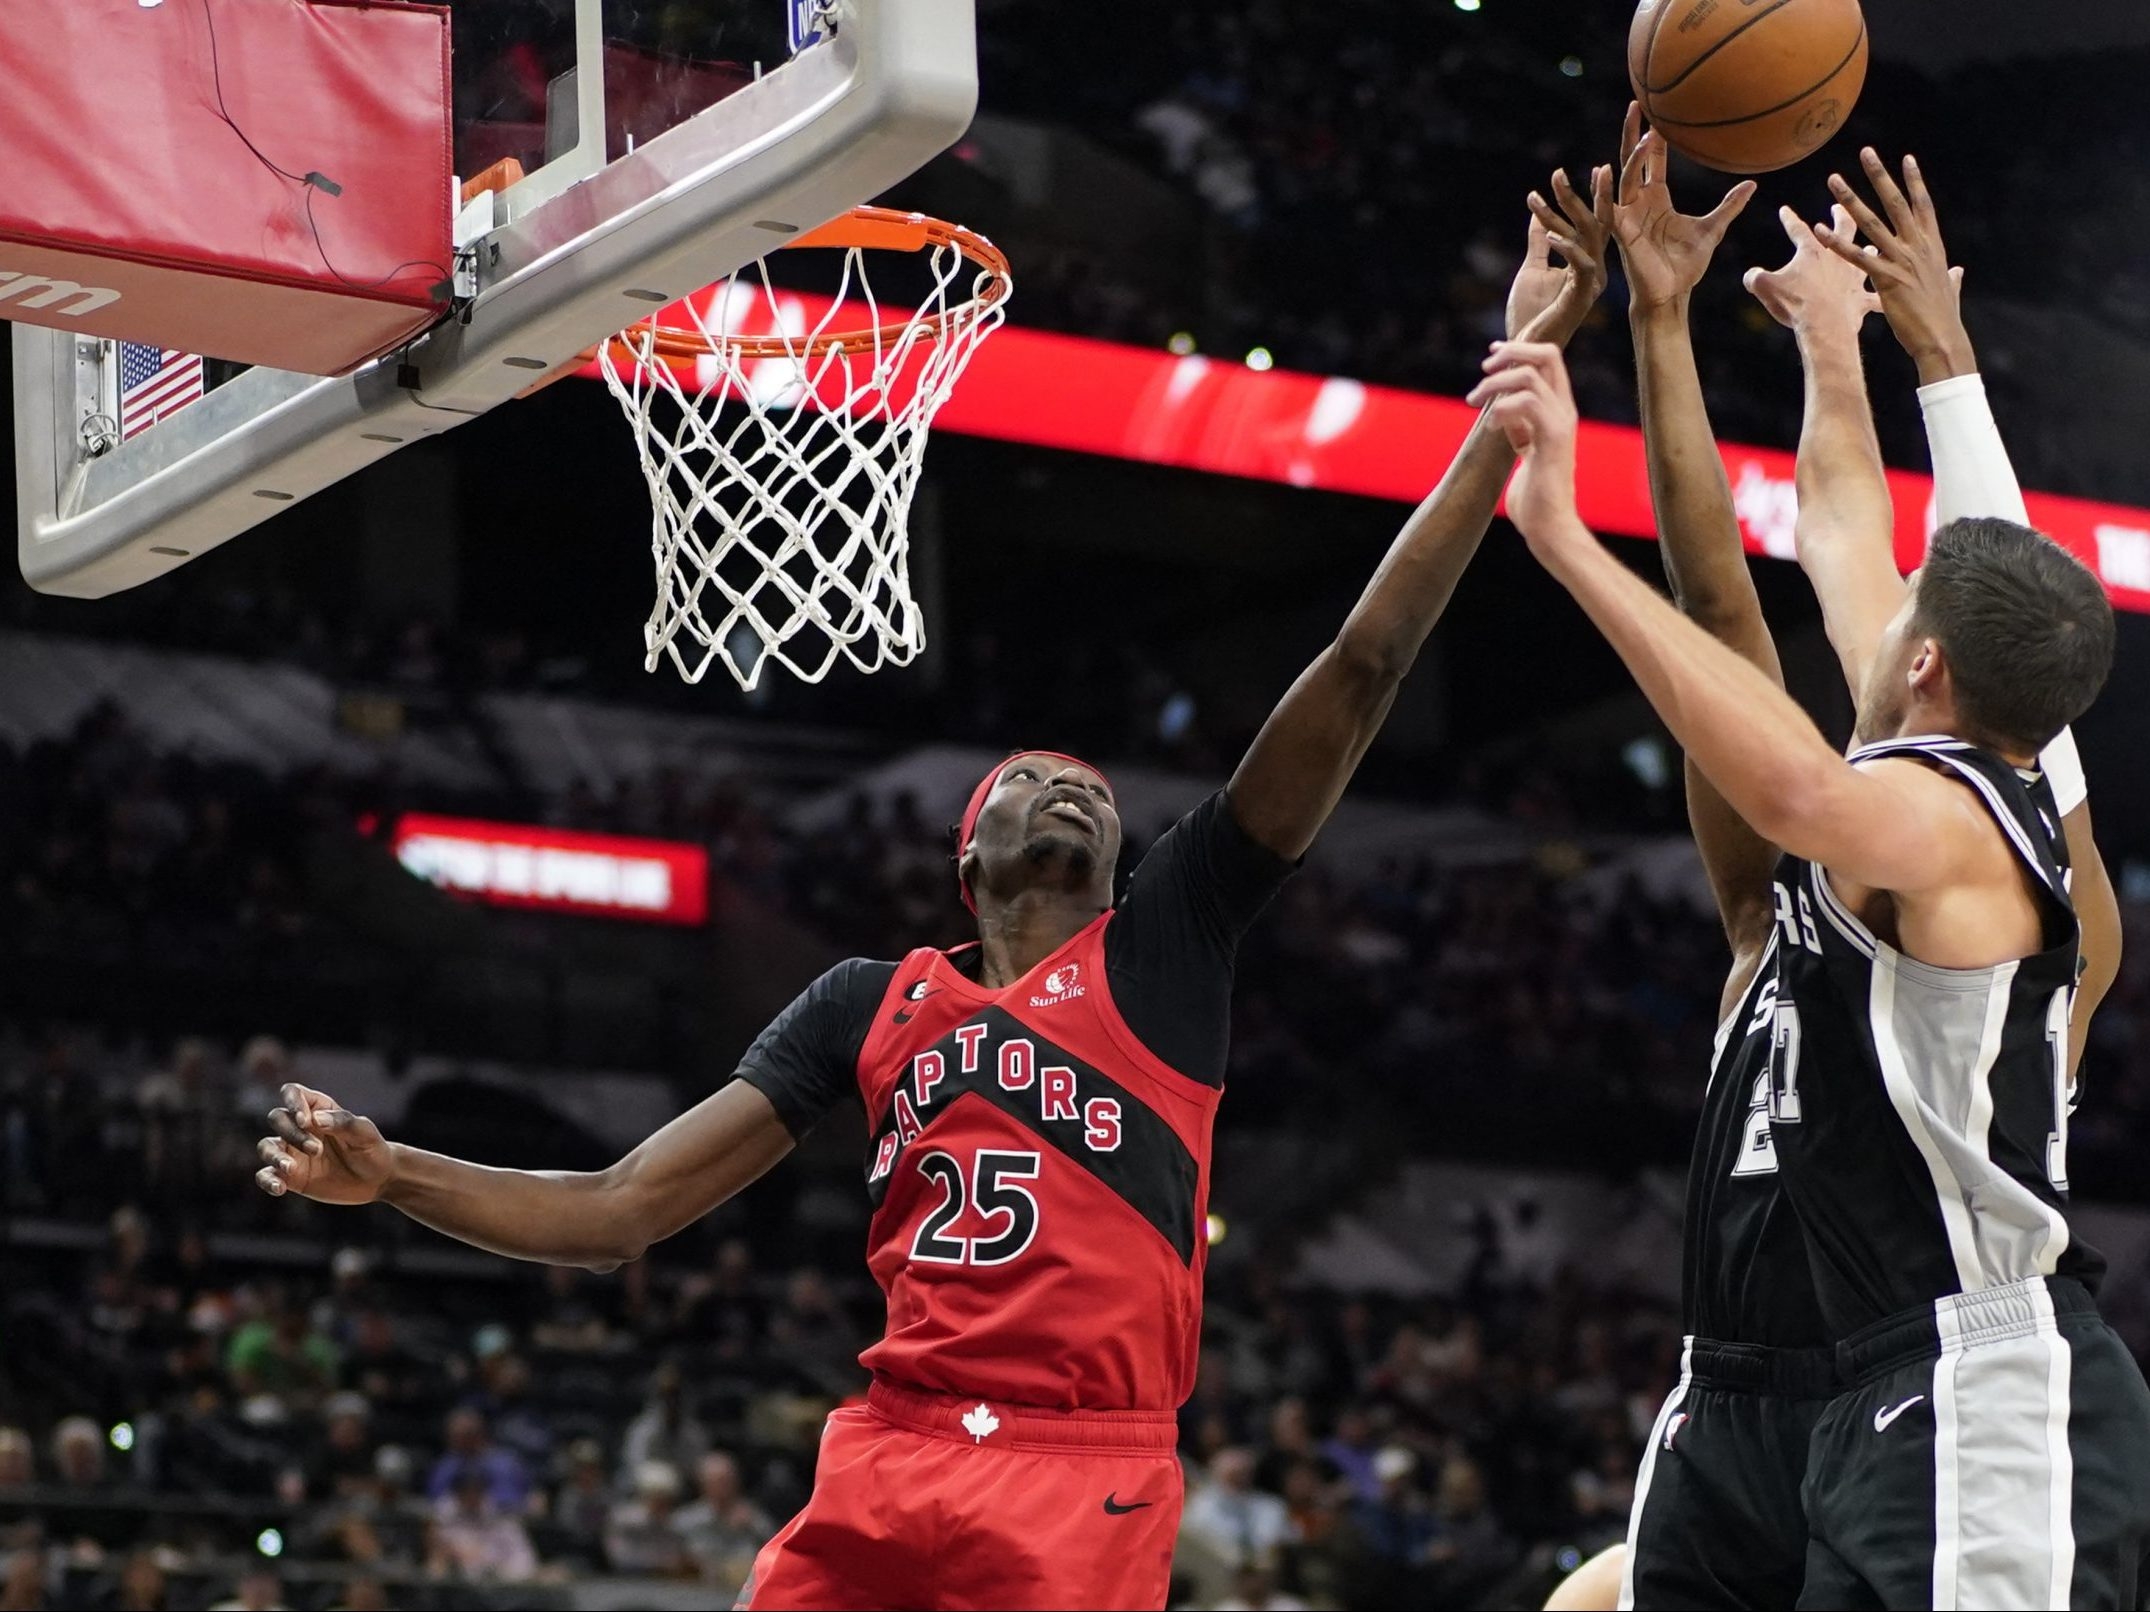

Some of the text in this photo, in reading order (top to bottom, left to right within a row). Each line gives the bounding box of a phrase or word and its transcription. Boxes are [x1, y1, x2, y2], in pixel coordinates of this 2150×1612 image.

[1029, 984, 1086, 1007] Sun Life
[868, 1023, 1122, 1183] RAPTORS
[908, 1148, 1041, 1267] 25
